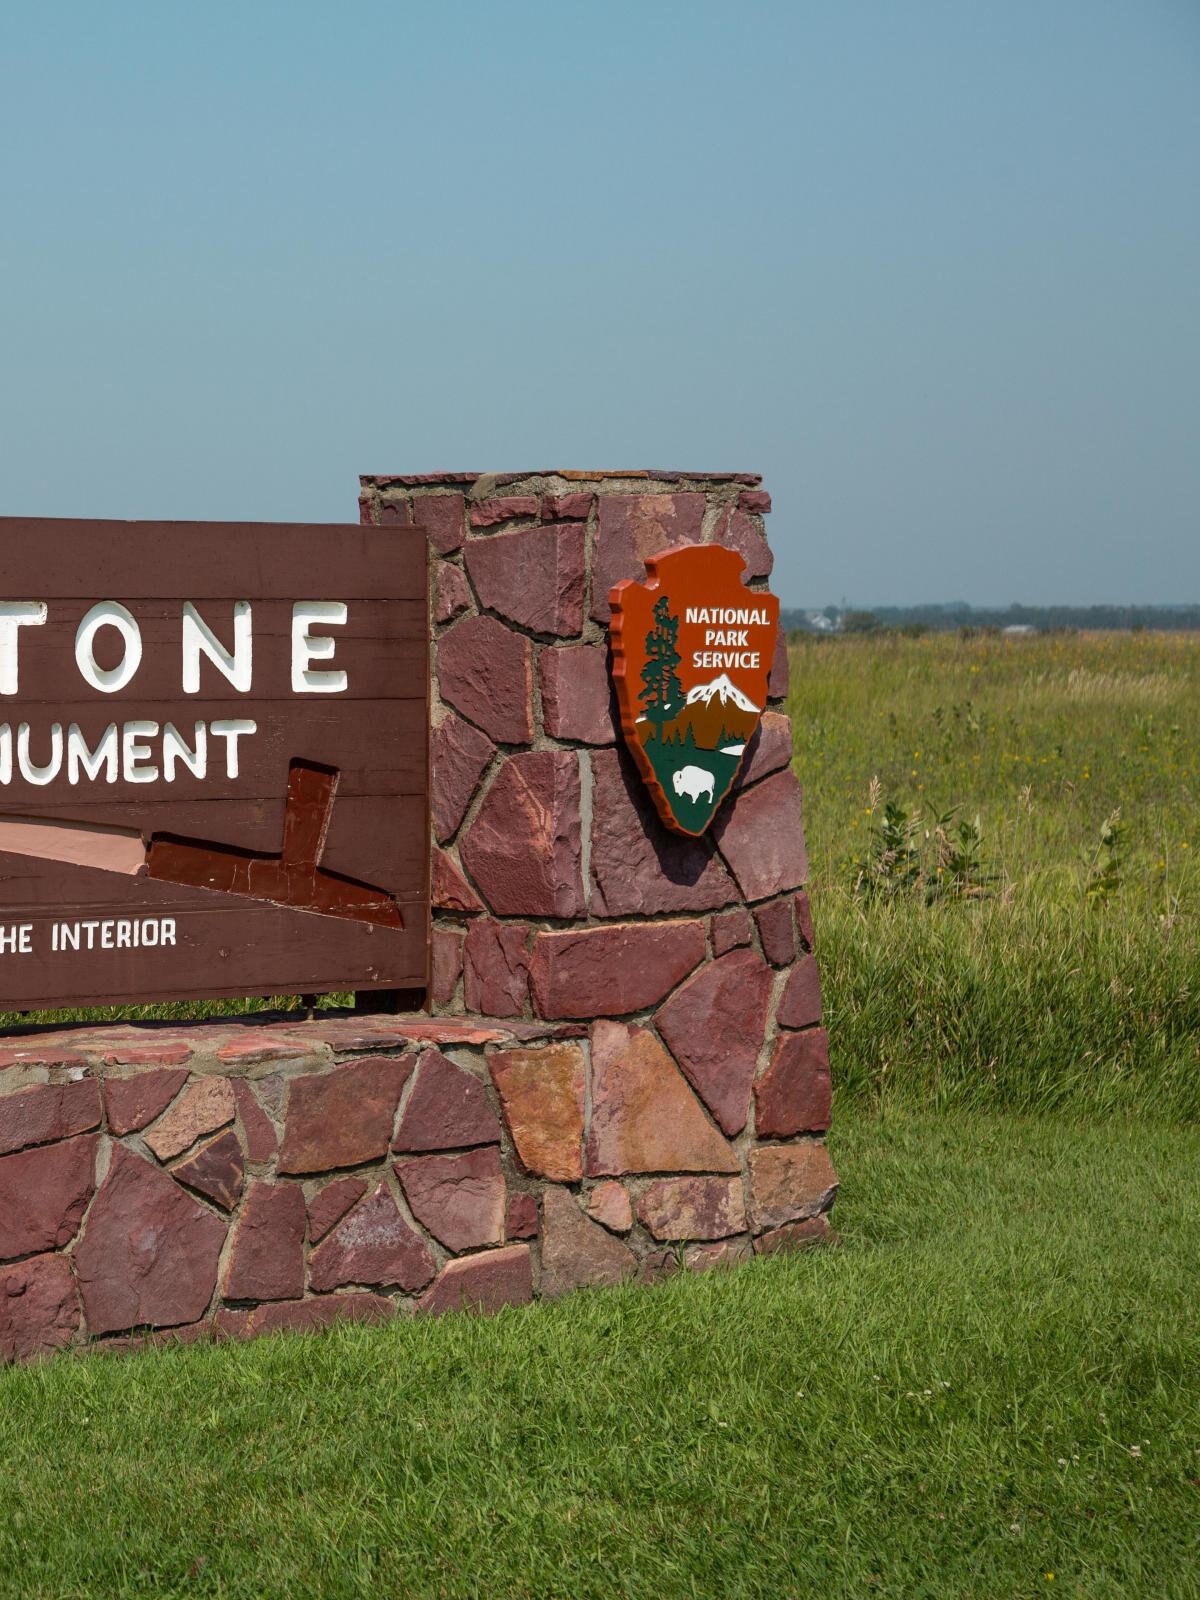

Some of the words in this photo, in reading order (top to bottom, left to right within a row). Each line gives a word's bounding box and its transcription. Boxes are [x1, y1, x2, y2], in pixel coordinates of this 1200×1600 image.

[685, 607, 771, 626] NATIONAL
[705, 629, 749, 647] PARK
[692, 651, 760, 669] SERVICE
[51, 917, 177, 952] INTERIOR
